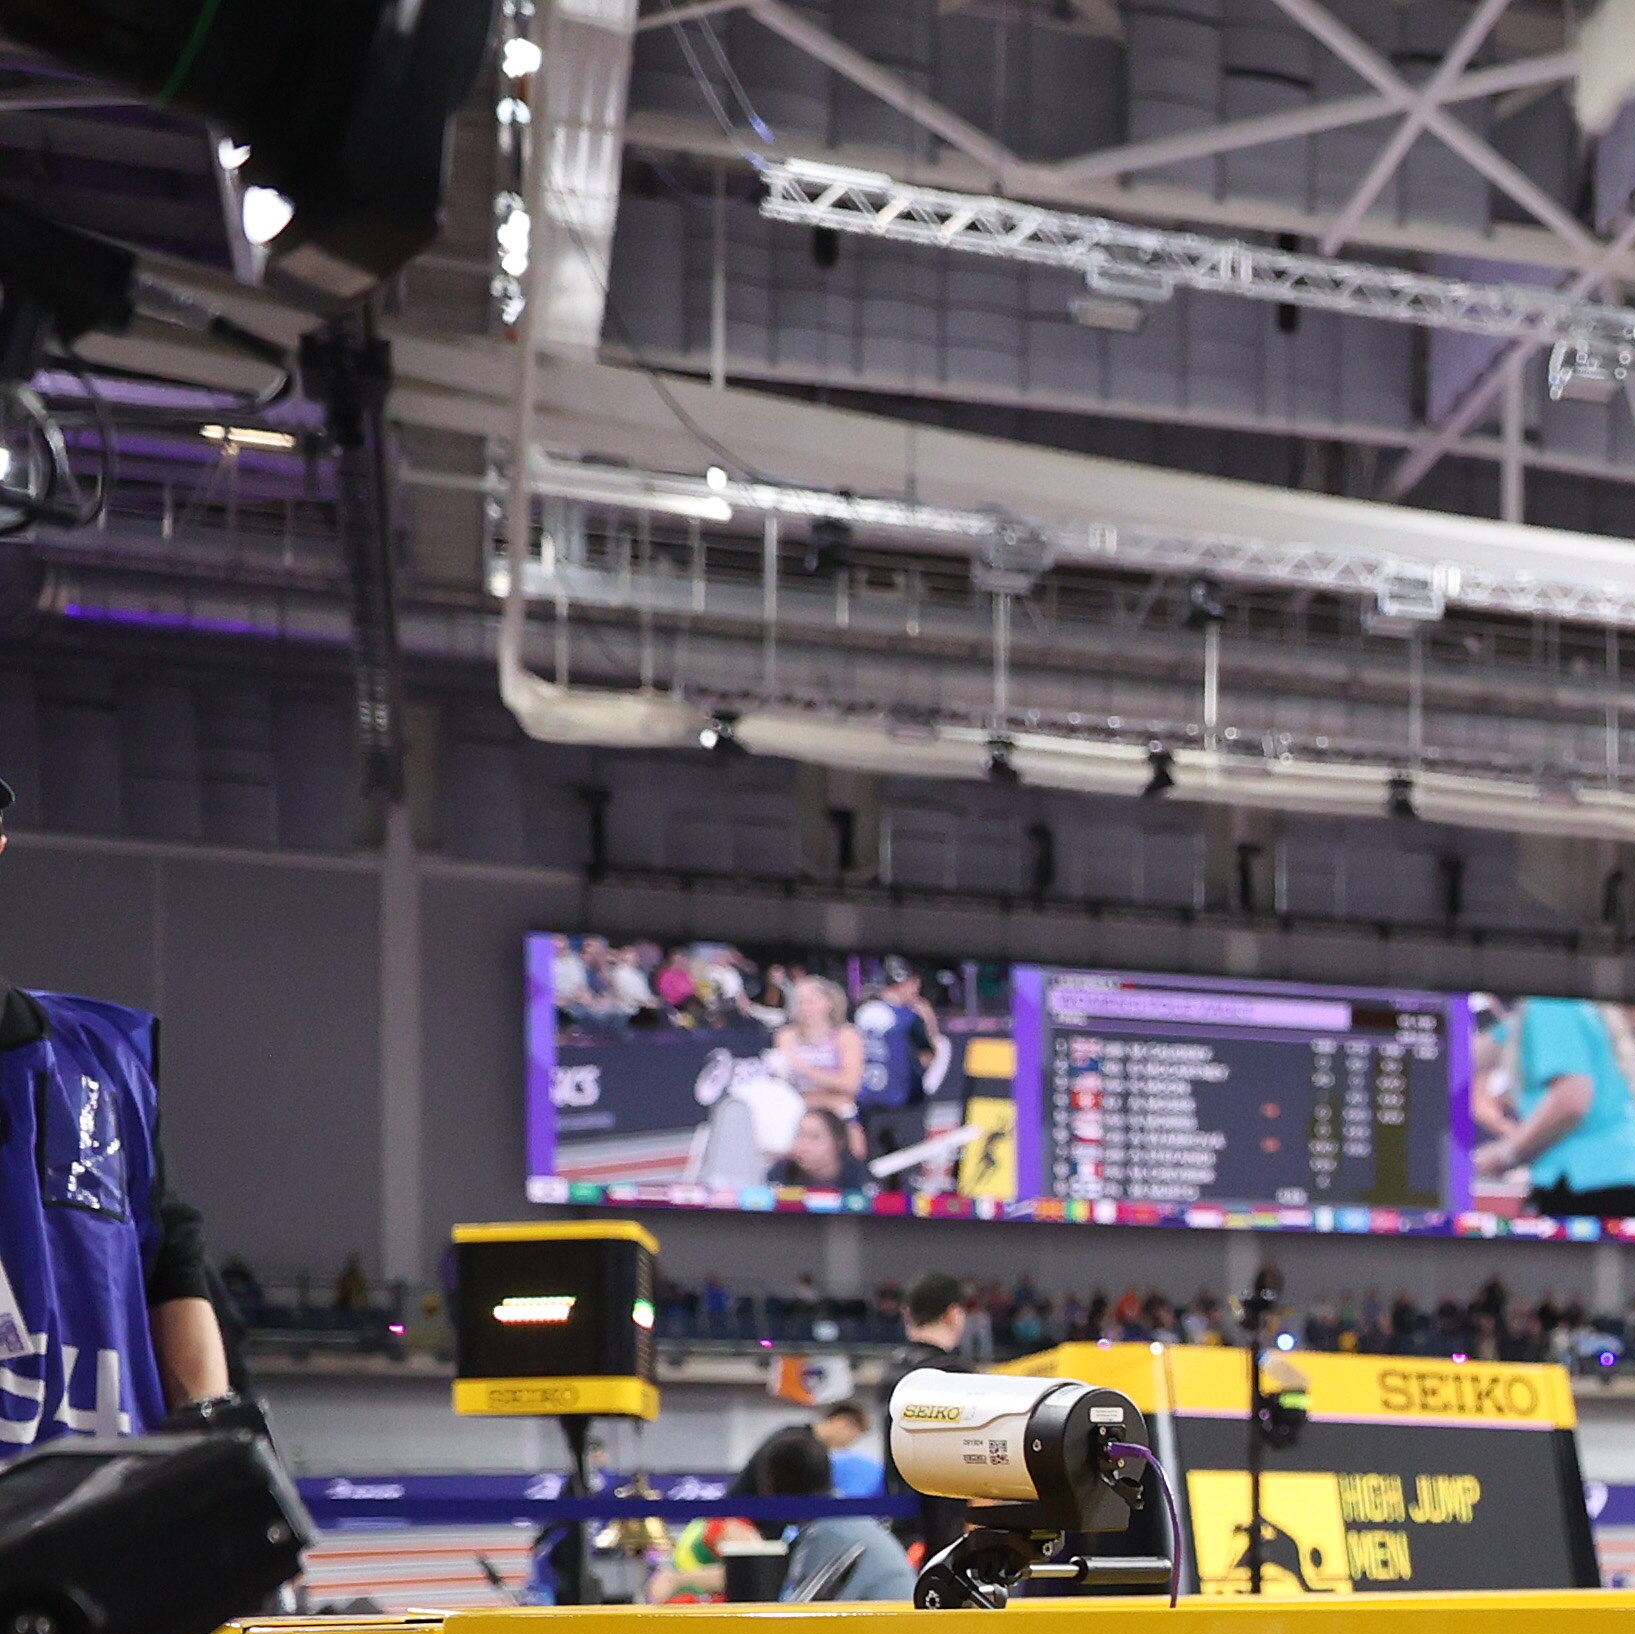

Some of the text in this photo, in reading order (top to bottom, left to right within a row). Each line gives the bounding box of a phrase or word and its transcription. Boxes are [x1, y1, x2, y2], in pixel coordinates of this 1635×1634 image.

[903, 1404, 960, 1421] SEIKO
[1378, 1369, 1539, 1416] SEIKO
[1338, 1472, 1481, 1523] HIGH JUMP
[1347, 1529, 1412, 1581] MEN
